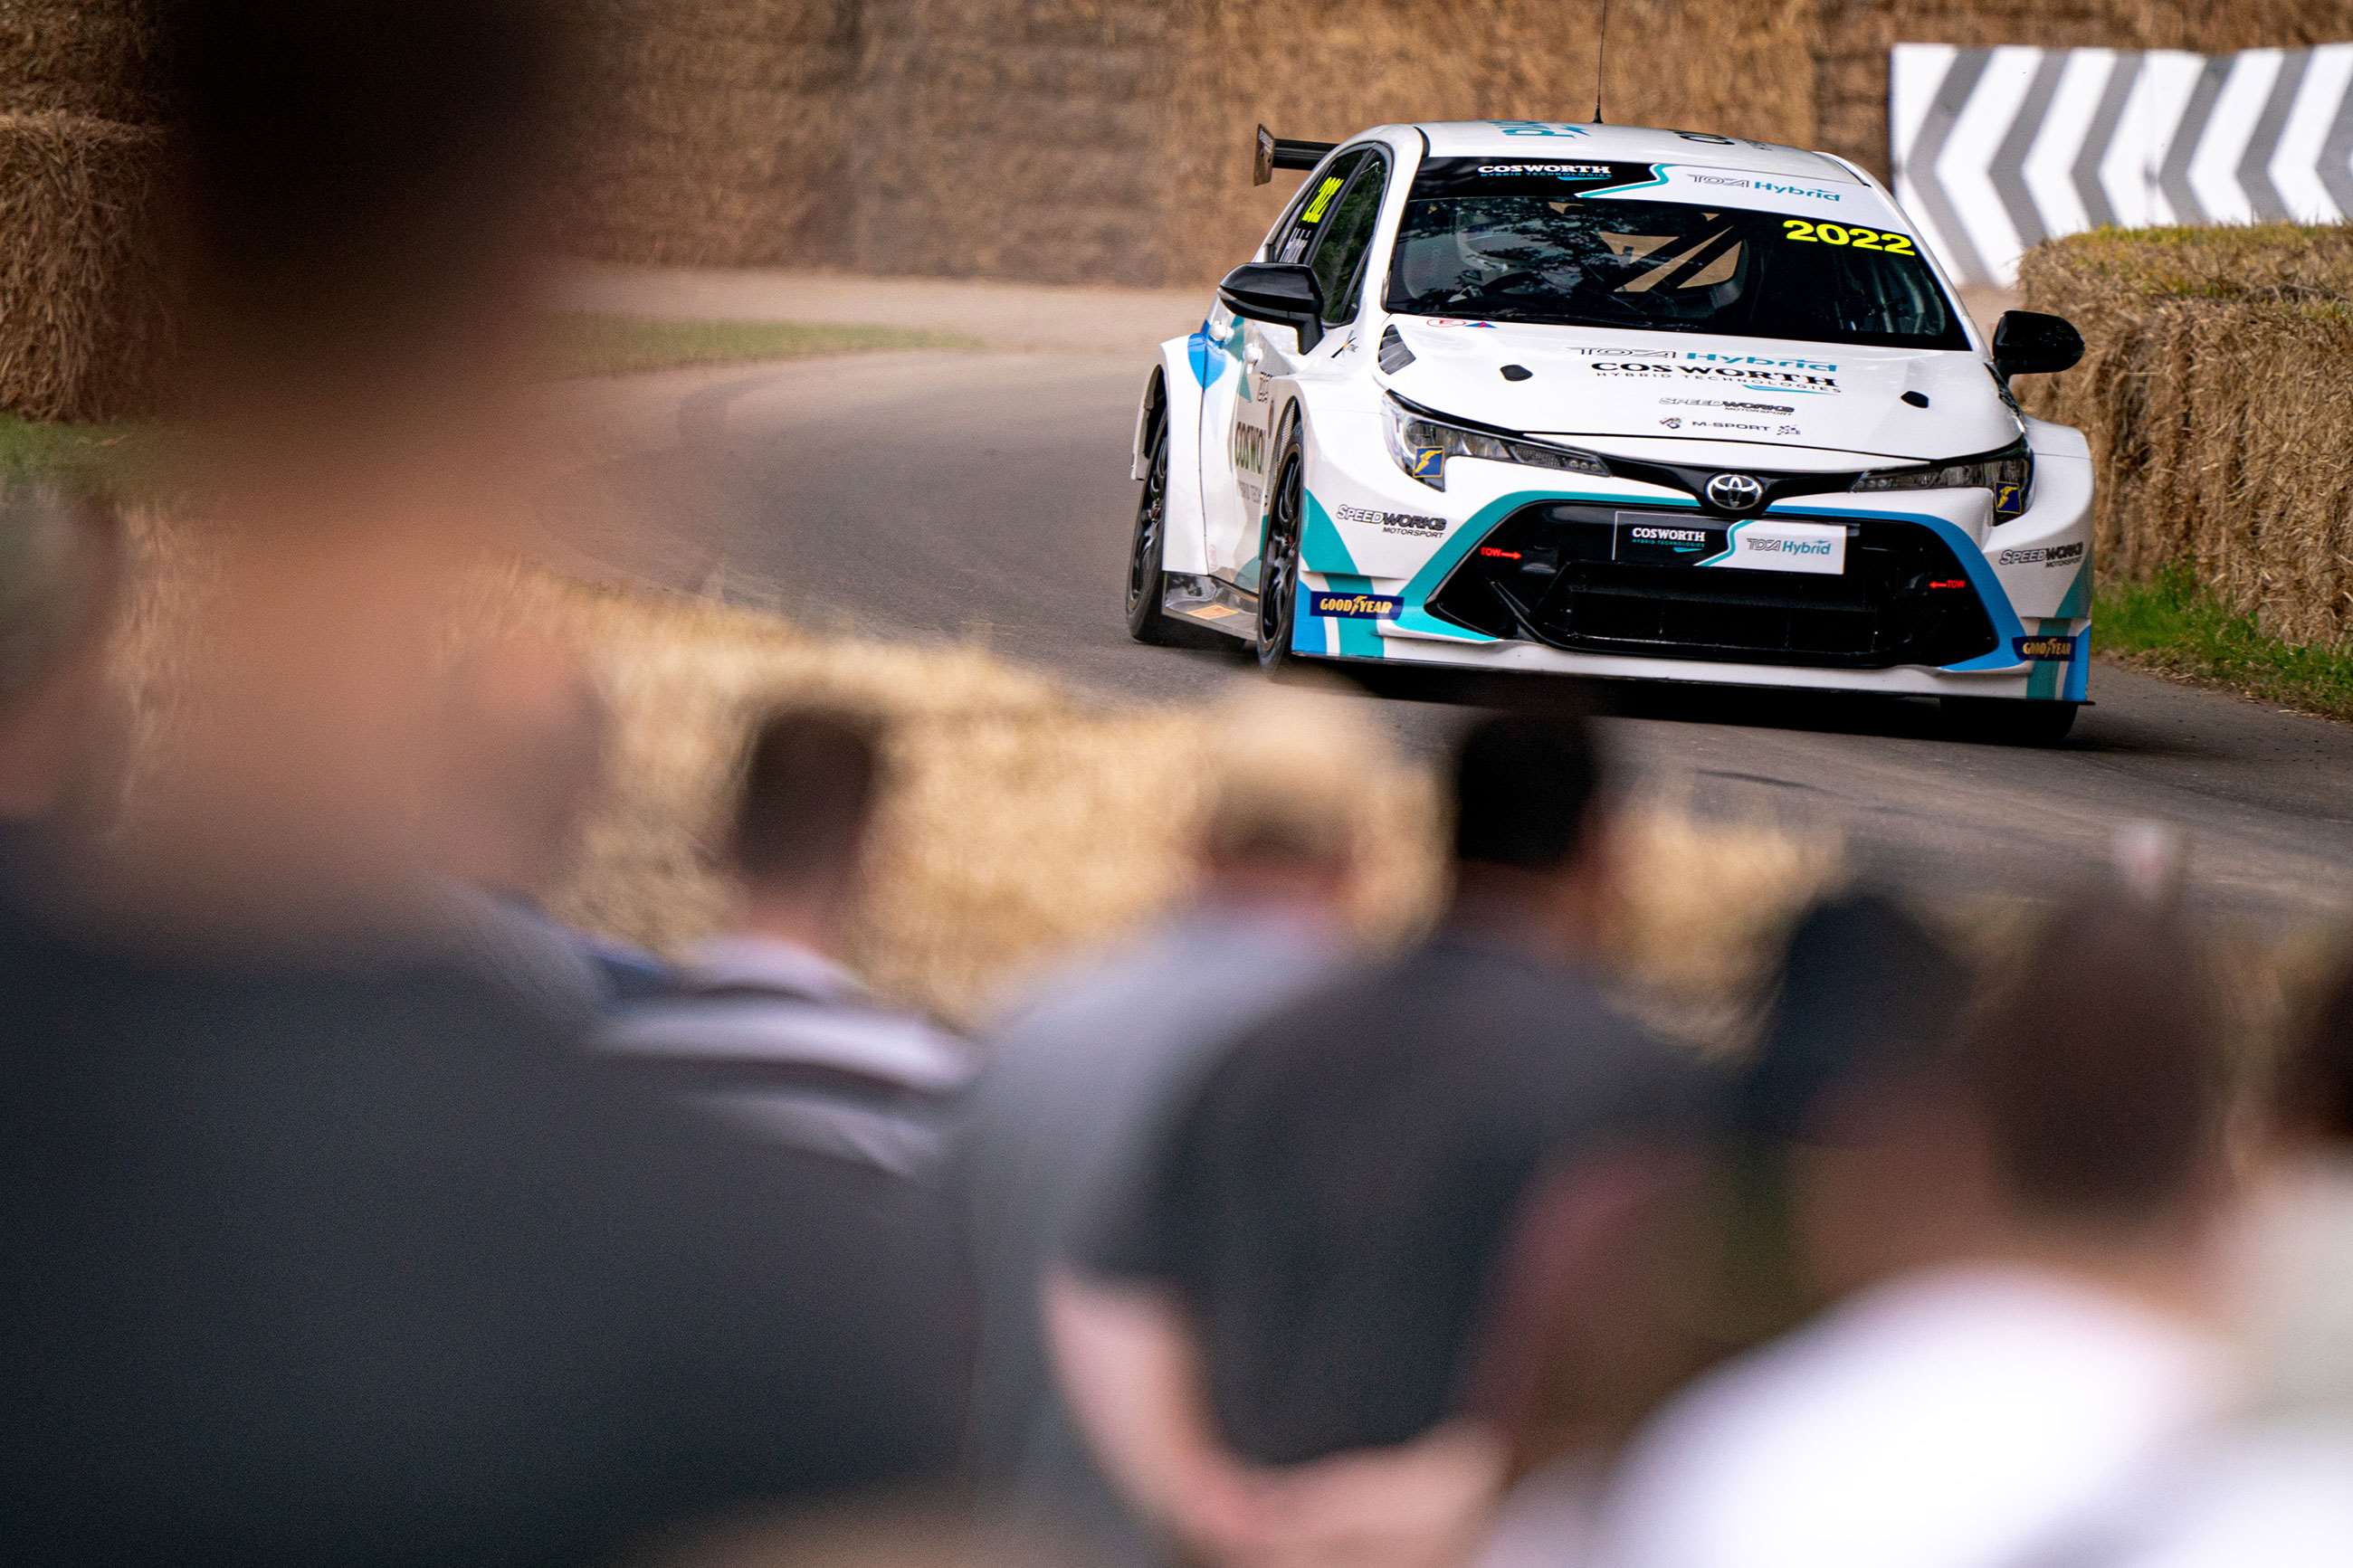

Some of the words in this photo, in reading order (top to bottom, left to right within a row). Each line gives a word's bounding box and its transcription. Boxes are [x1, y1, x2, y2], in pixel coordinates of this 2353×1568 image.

[1477, 165, 1612, 174] COSWORTH
[1754, 181, 1840, 202] Hybrid
[1783, 220, 1916, 256] 2022
[1687, 352, 1836, 372] Hybrid
[1591, 362, 1839, 387] COSWORTH
[1684, 375, 1842, 394] TECHNOLOGIES
[1692, 421, 1771, 432] M-SPORT
[1336, 504, 1447, 531] SPEEDWORKS
[1382, 527, 1444, 539] MOTORSPORT
[1632, 527, 1706, 542] COSWORTH
[1481, 546, 1501, 556] TOW
[1782, 539, 1831, 556] Hybrid
[1946, 579, 1967, 588] TOW
